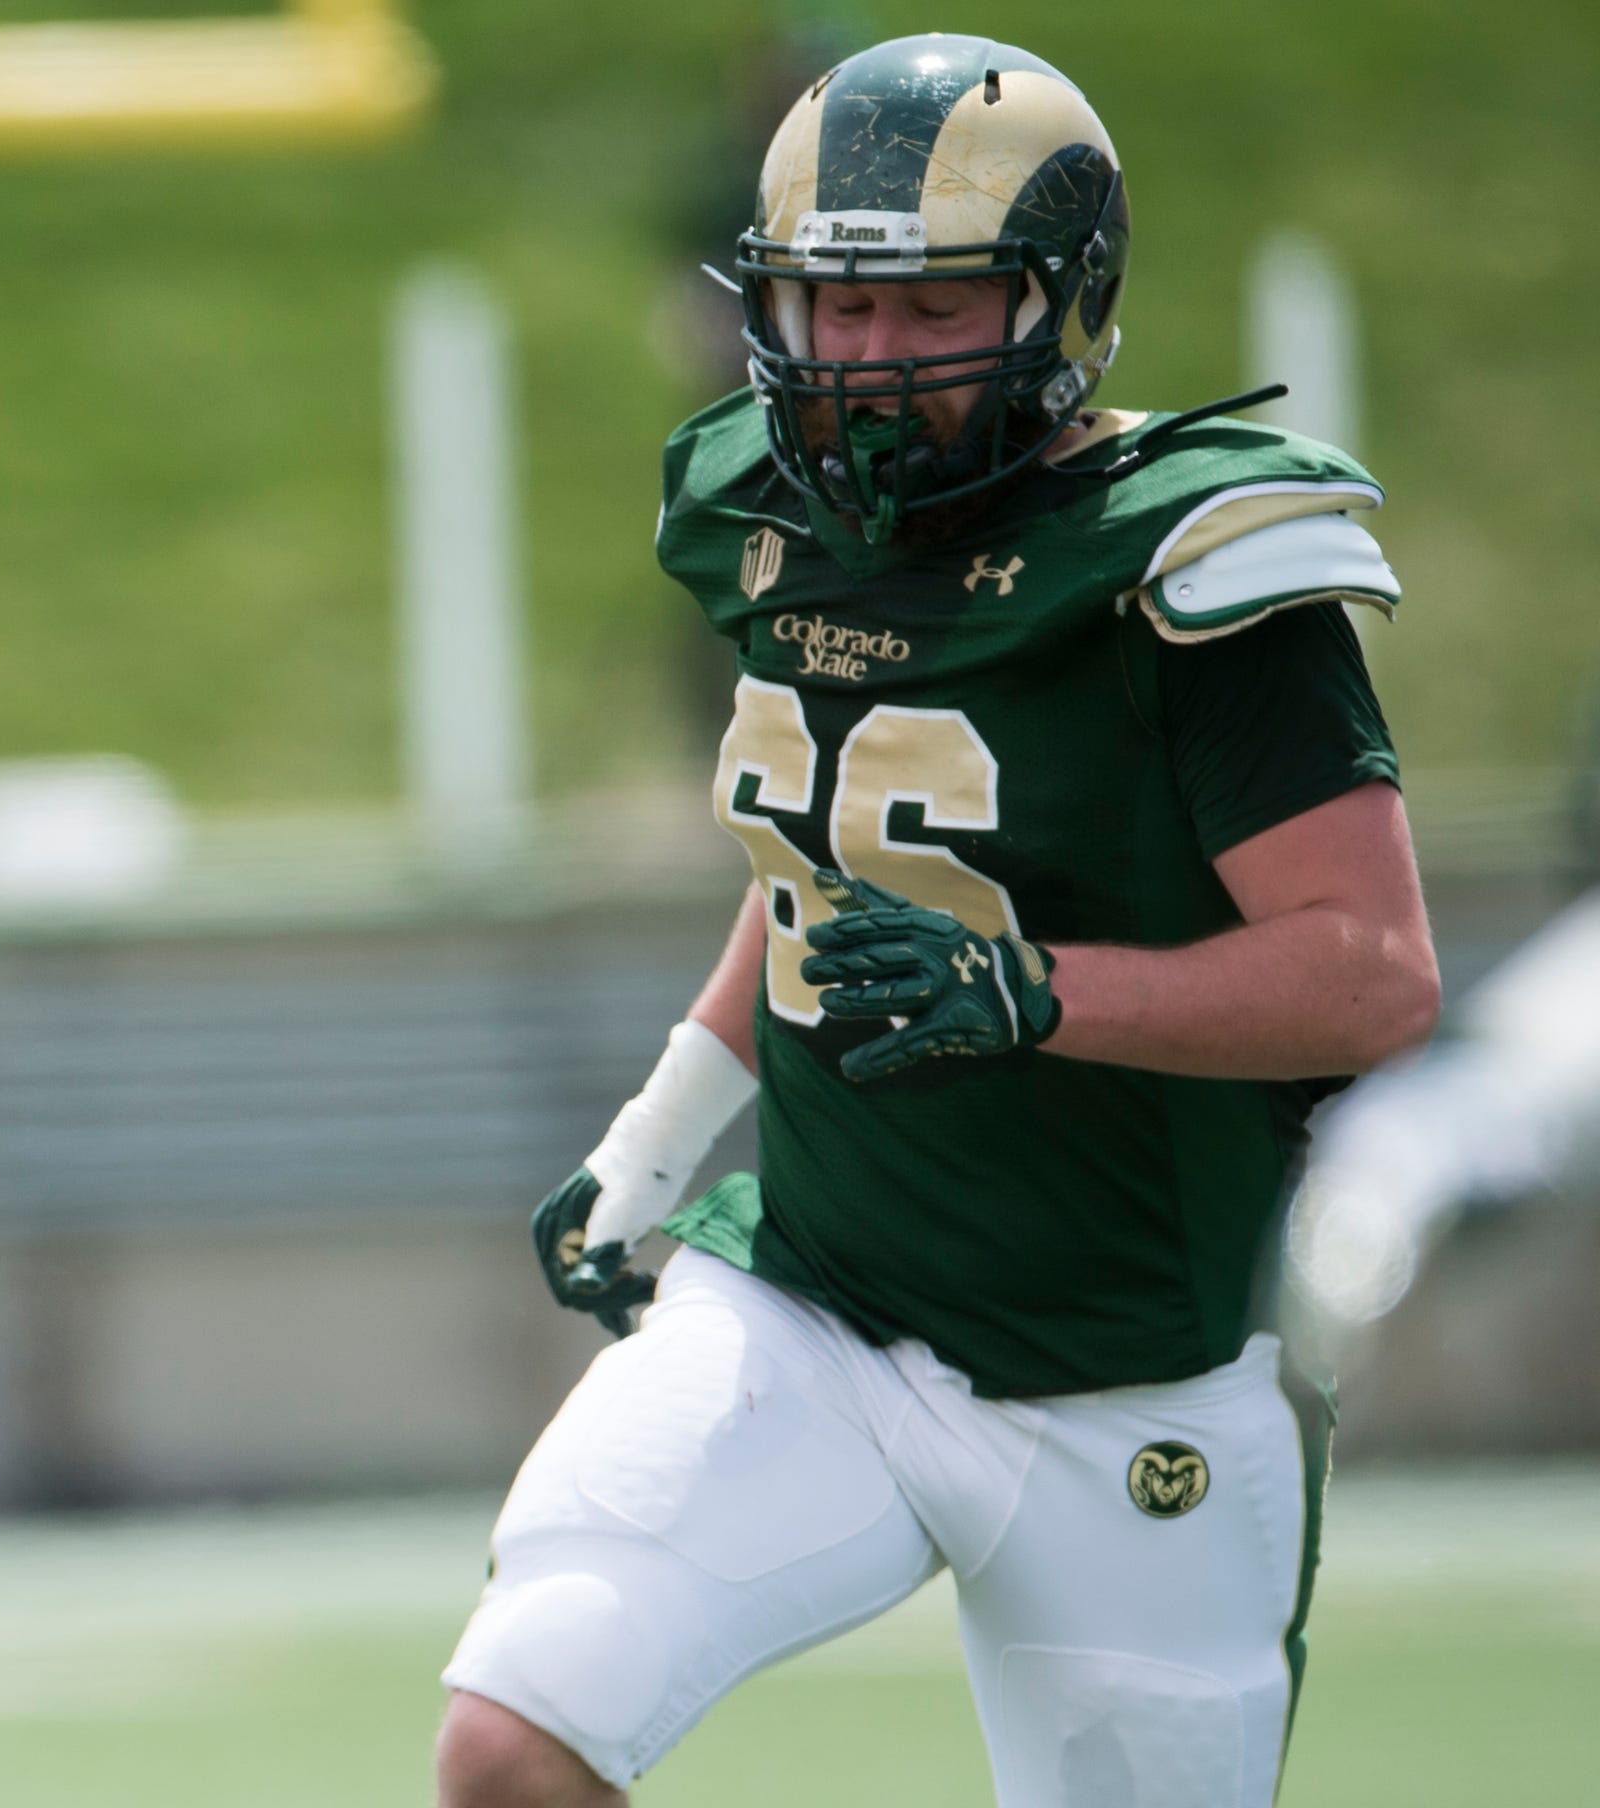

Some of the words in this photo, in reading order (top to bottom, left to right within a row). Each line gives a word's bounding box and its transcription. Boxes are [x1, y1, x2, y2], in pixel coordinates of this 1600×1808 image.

[830, 221, 887, 242] Rams
[773, 613, 911, 662] Colorado
[799, 643, 868, 682] State
